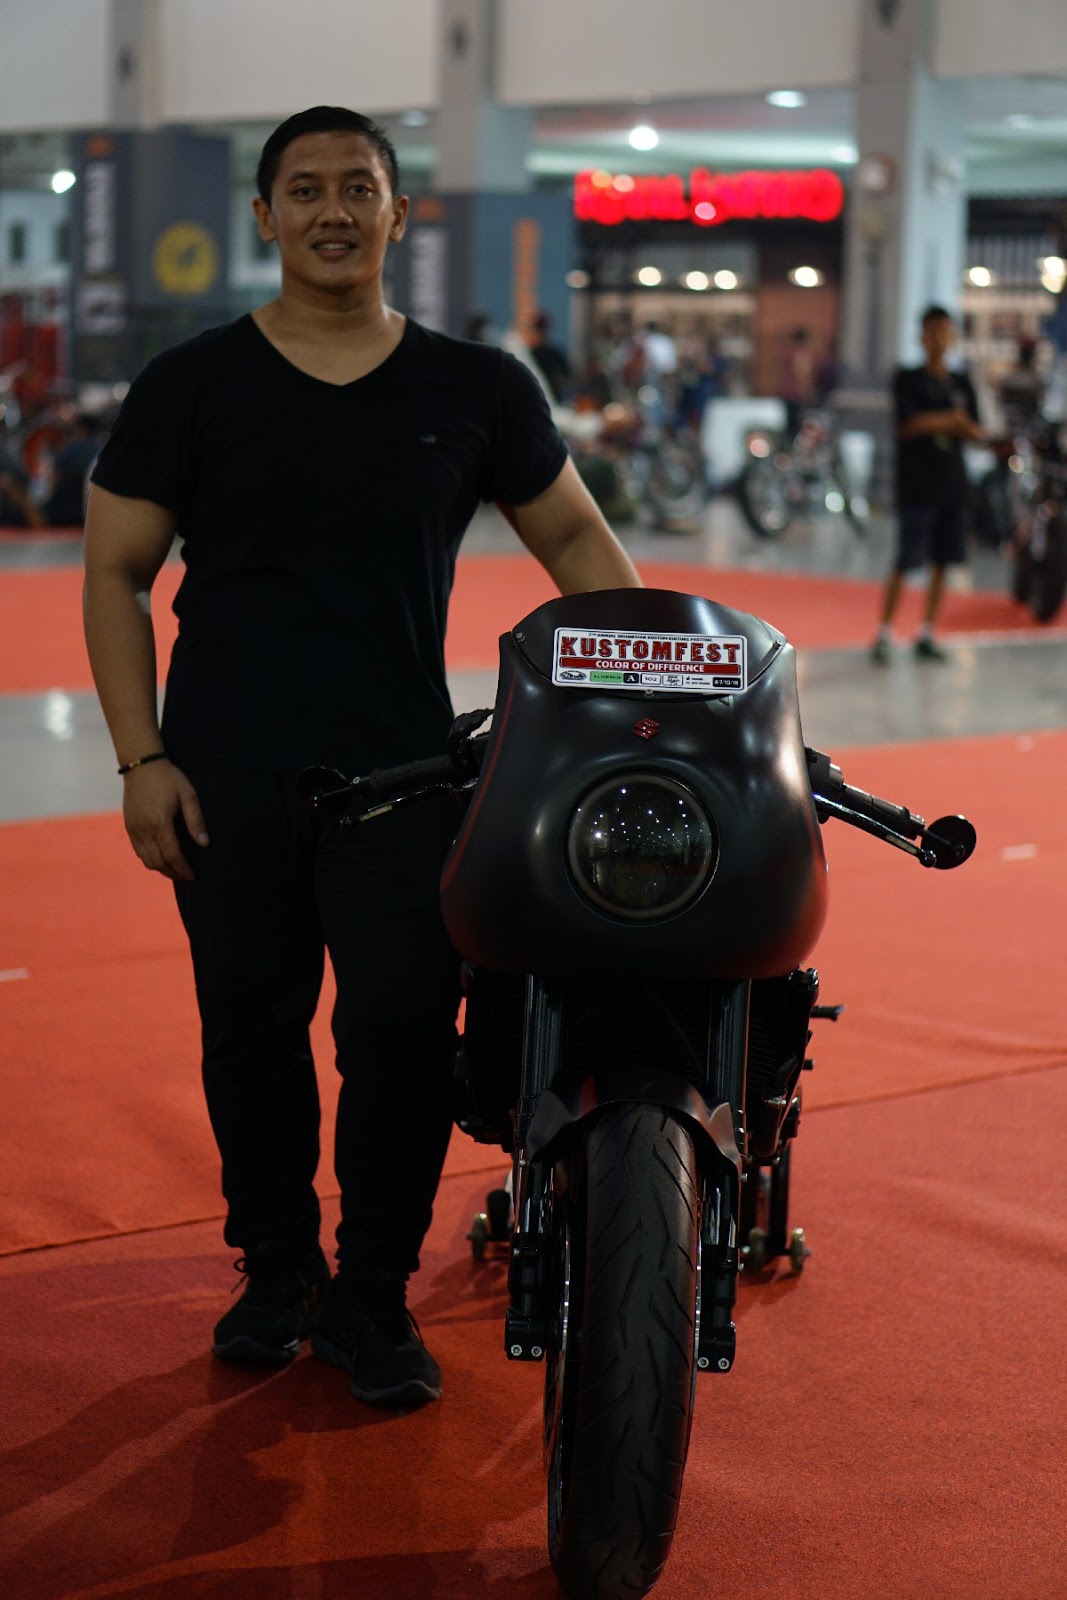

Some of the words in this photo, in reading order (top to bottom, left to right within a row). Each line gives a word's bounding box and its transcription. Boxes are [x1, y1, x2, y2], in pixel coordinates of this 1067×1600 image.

[560, 636, 740, 662] KUSTOMFEST
[596, 660, 630, 669] COLOR
[631, 662, 645, 670] OF
[647, 662, 705, 673] DIFFERENCE
